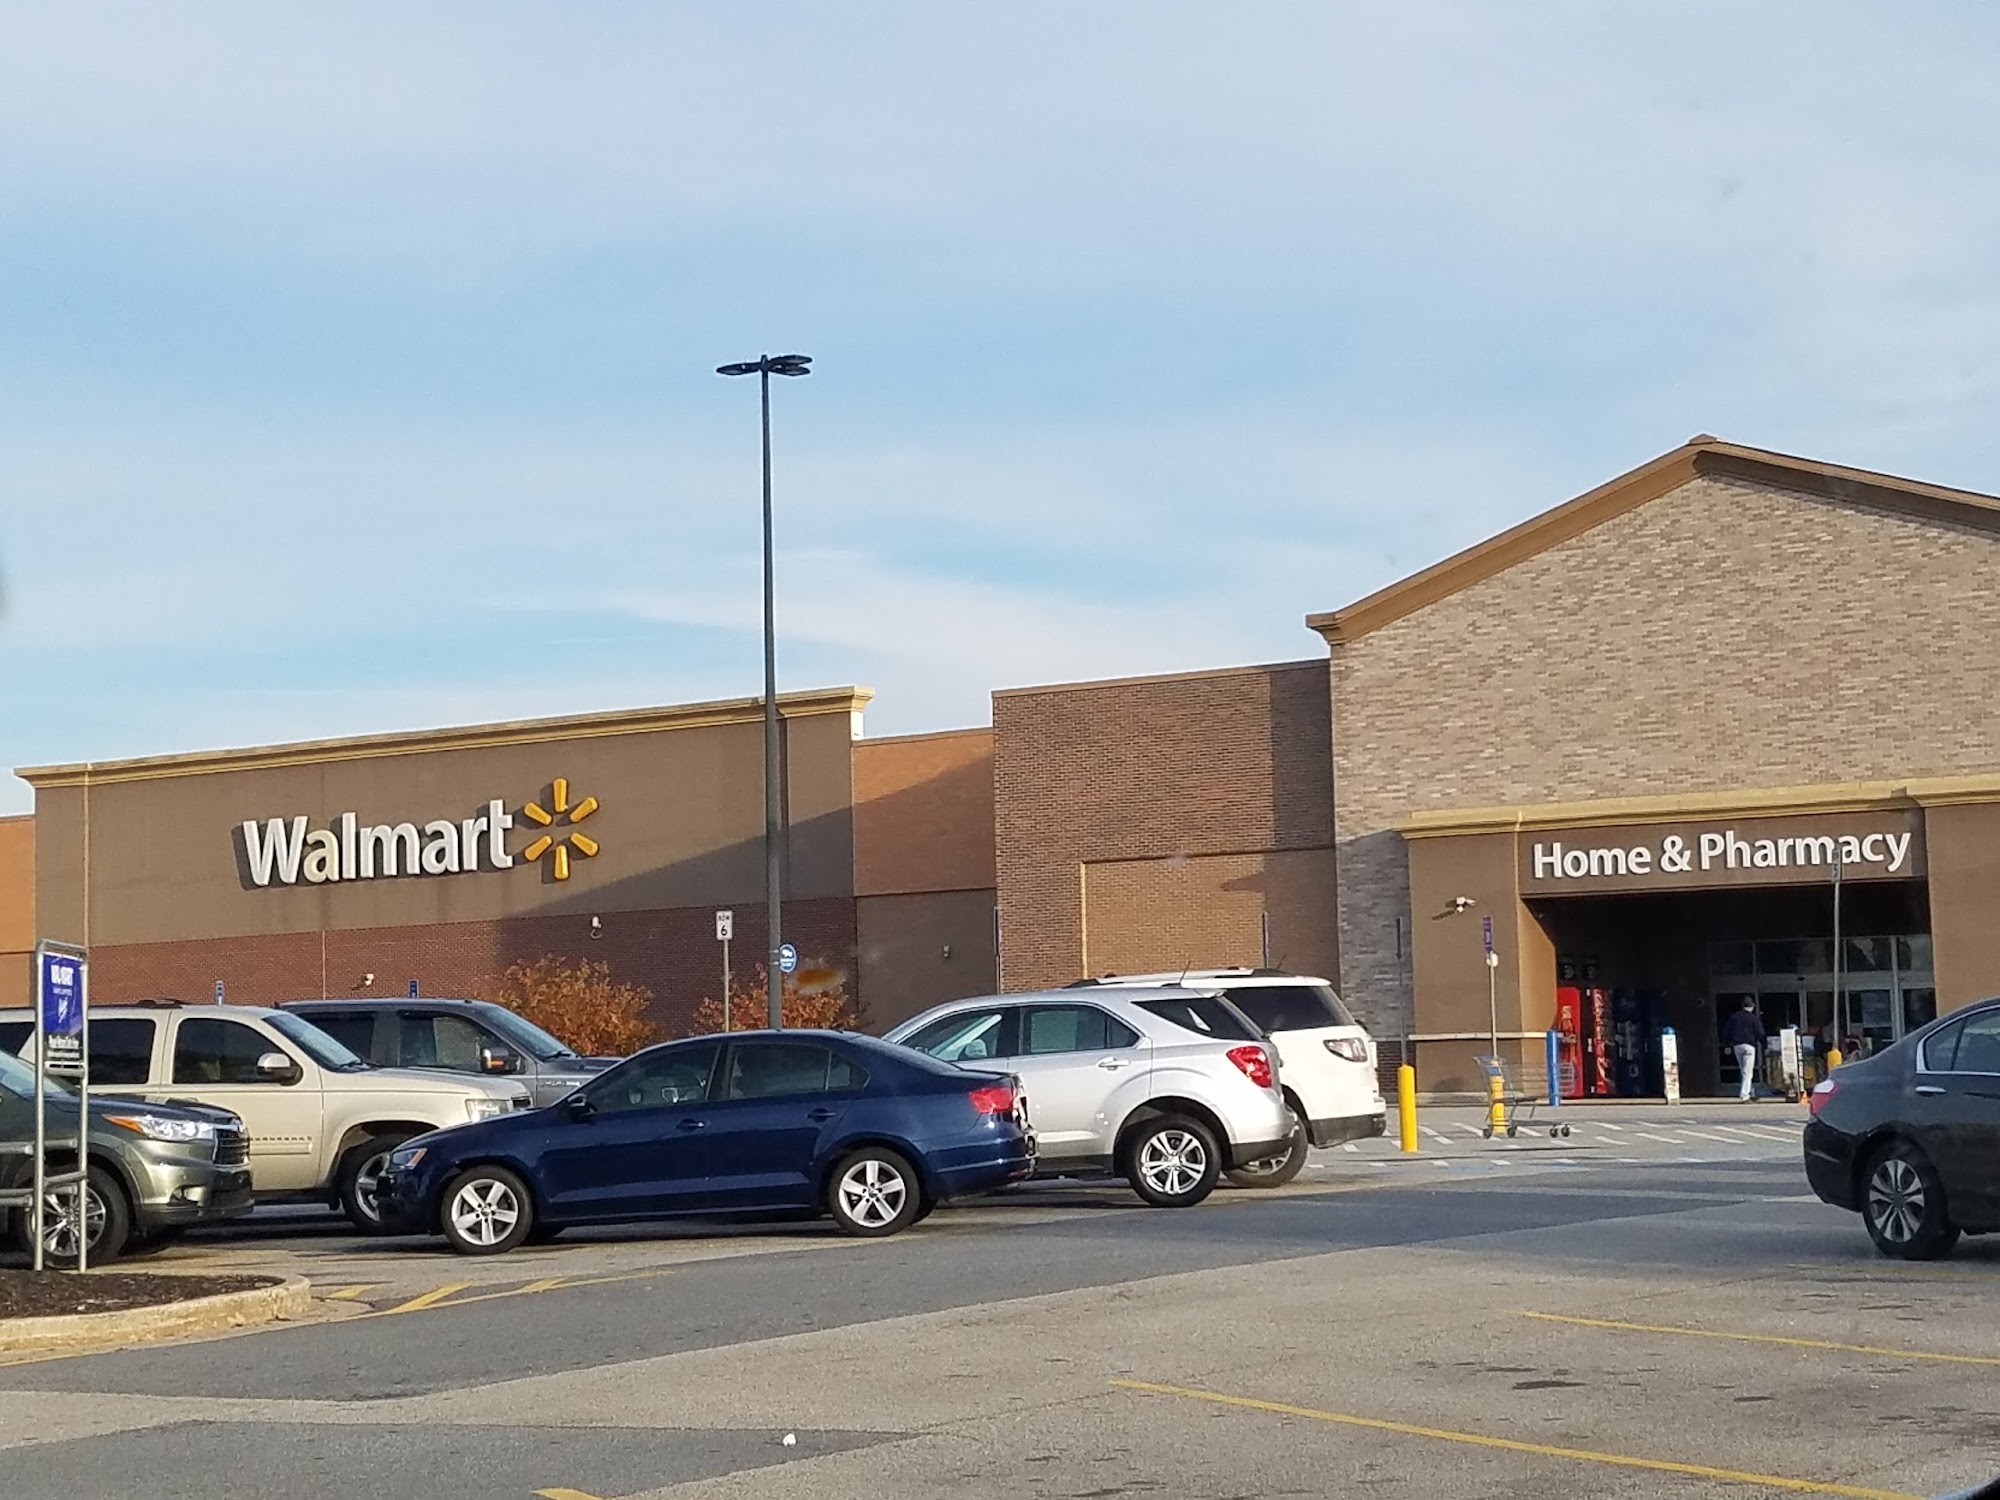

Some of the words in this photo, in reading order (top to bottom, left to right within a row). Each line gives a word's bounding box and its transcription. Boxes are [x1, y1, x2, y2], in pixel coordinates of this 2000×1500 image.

[243, 799, 514, 887] Walmart
[1533, 841, 1652, 879] Home
[1660, 834, 1692, 873] &
[1700, 829, 1912, 873] Pharmacy
[720, 924, 728, 937] 6
